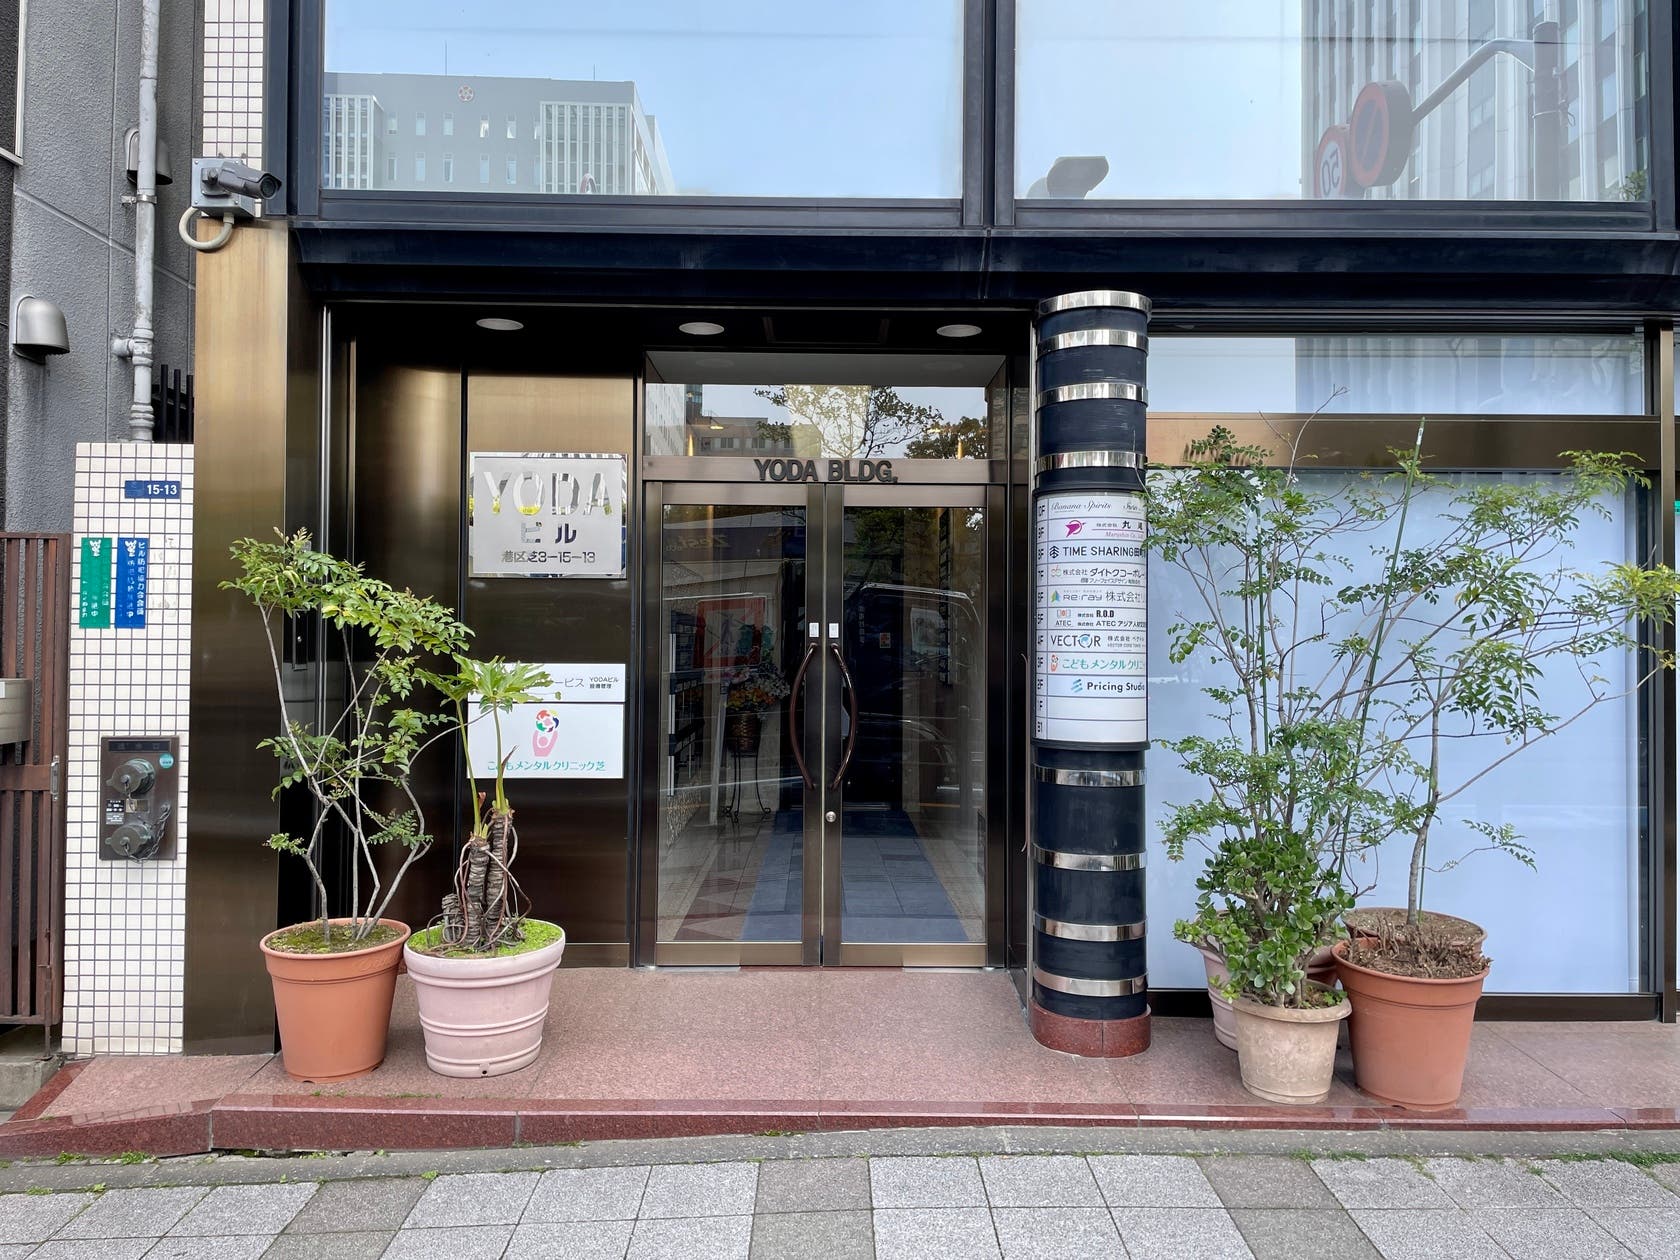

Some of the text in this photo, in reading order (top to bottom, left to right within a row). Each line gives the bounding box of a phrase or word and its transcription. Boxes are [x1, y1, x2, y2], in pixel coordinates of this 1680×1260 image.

[754, 459, 818, 482] YODA
[147, 484, 178, 496] 15-13
[483, 471, 612, 516] YODA
[520, 522, 577, 544] ビル
[1063, 546, 1087, 556] TIME
[1096, 610, 1115, 618] R.O.D
[1087, 681, 1123, 693] Pricing
